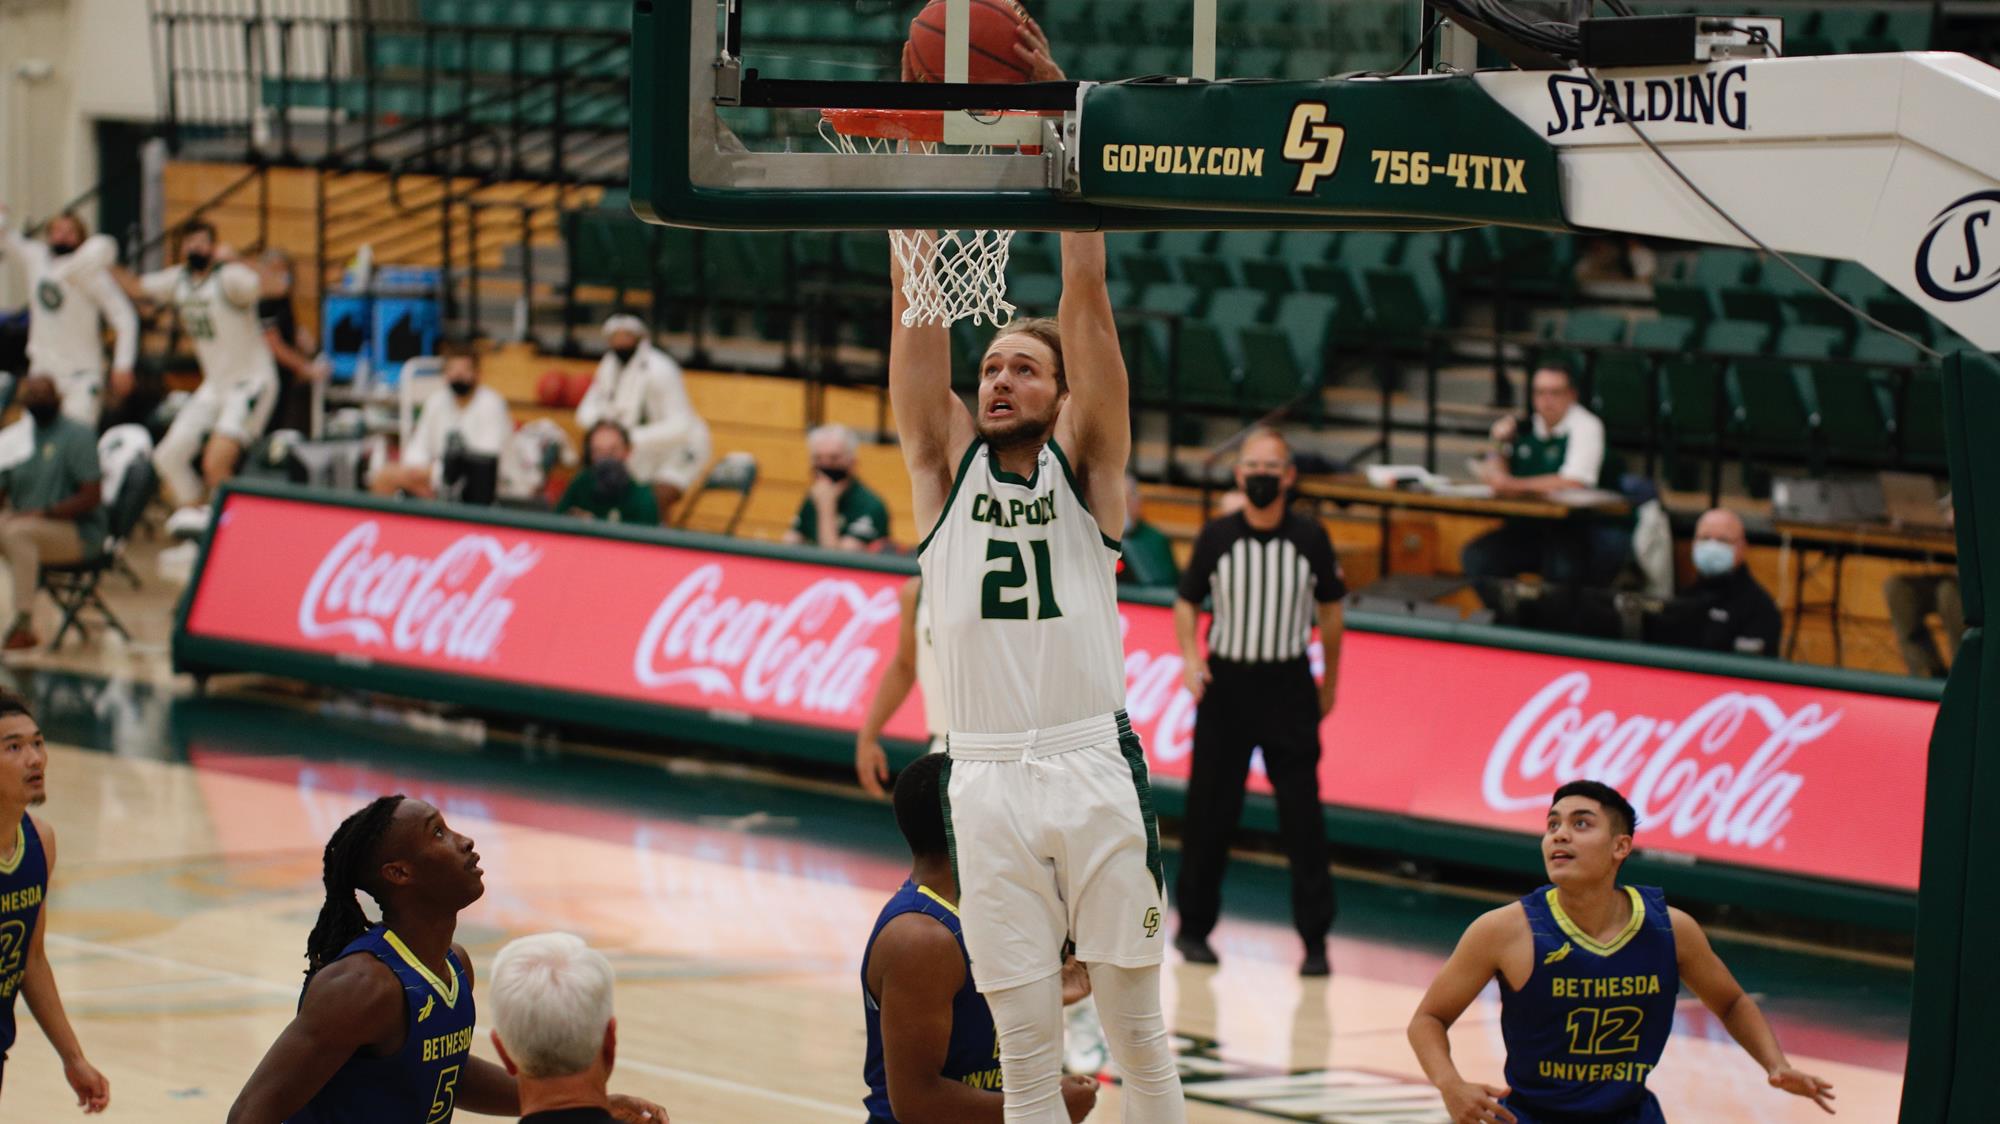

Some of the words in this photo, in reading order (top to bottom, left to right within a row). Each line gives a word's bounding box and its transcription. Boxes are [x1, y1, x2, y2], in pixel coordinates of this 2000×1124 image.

[1547, 65, 1747, 136] SPALDING
[1103, 144, 1264, 176] GOPOLY.COM
[1371, 150, 1527, 193] 756-4TIX
[981, 538, 1064, 620] 21
[0, 884, 42, 912] HESDA
[1552, 975, 1661, 998] BETHESDA
[1566, 1006, 1644, 1054] 12
[426, 1064, 460, 1124] 5
